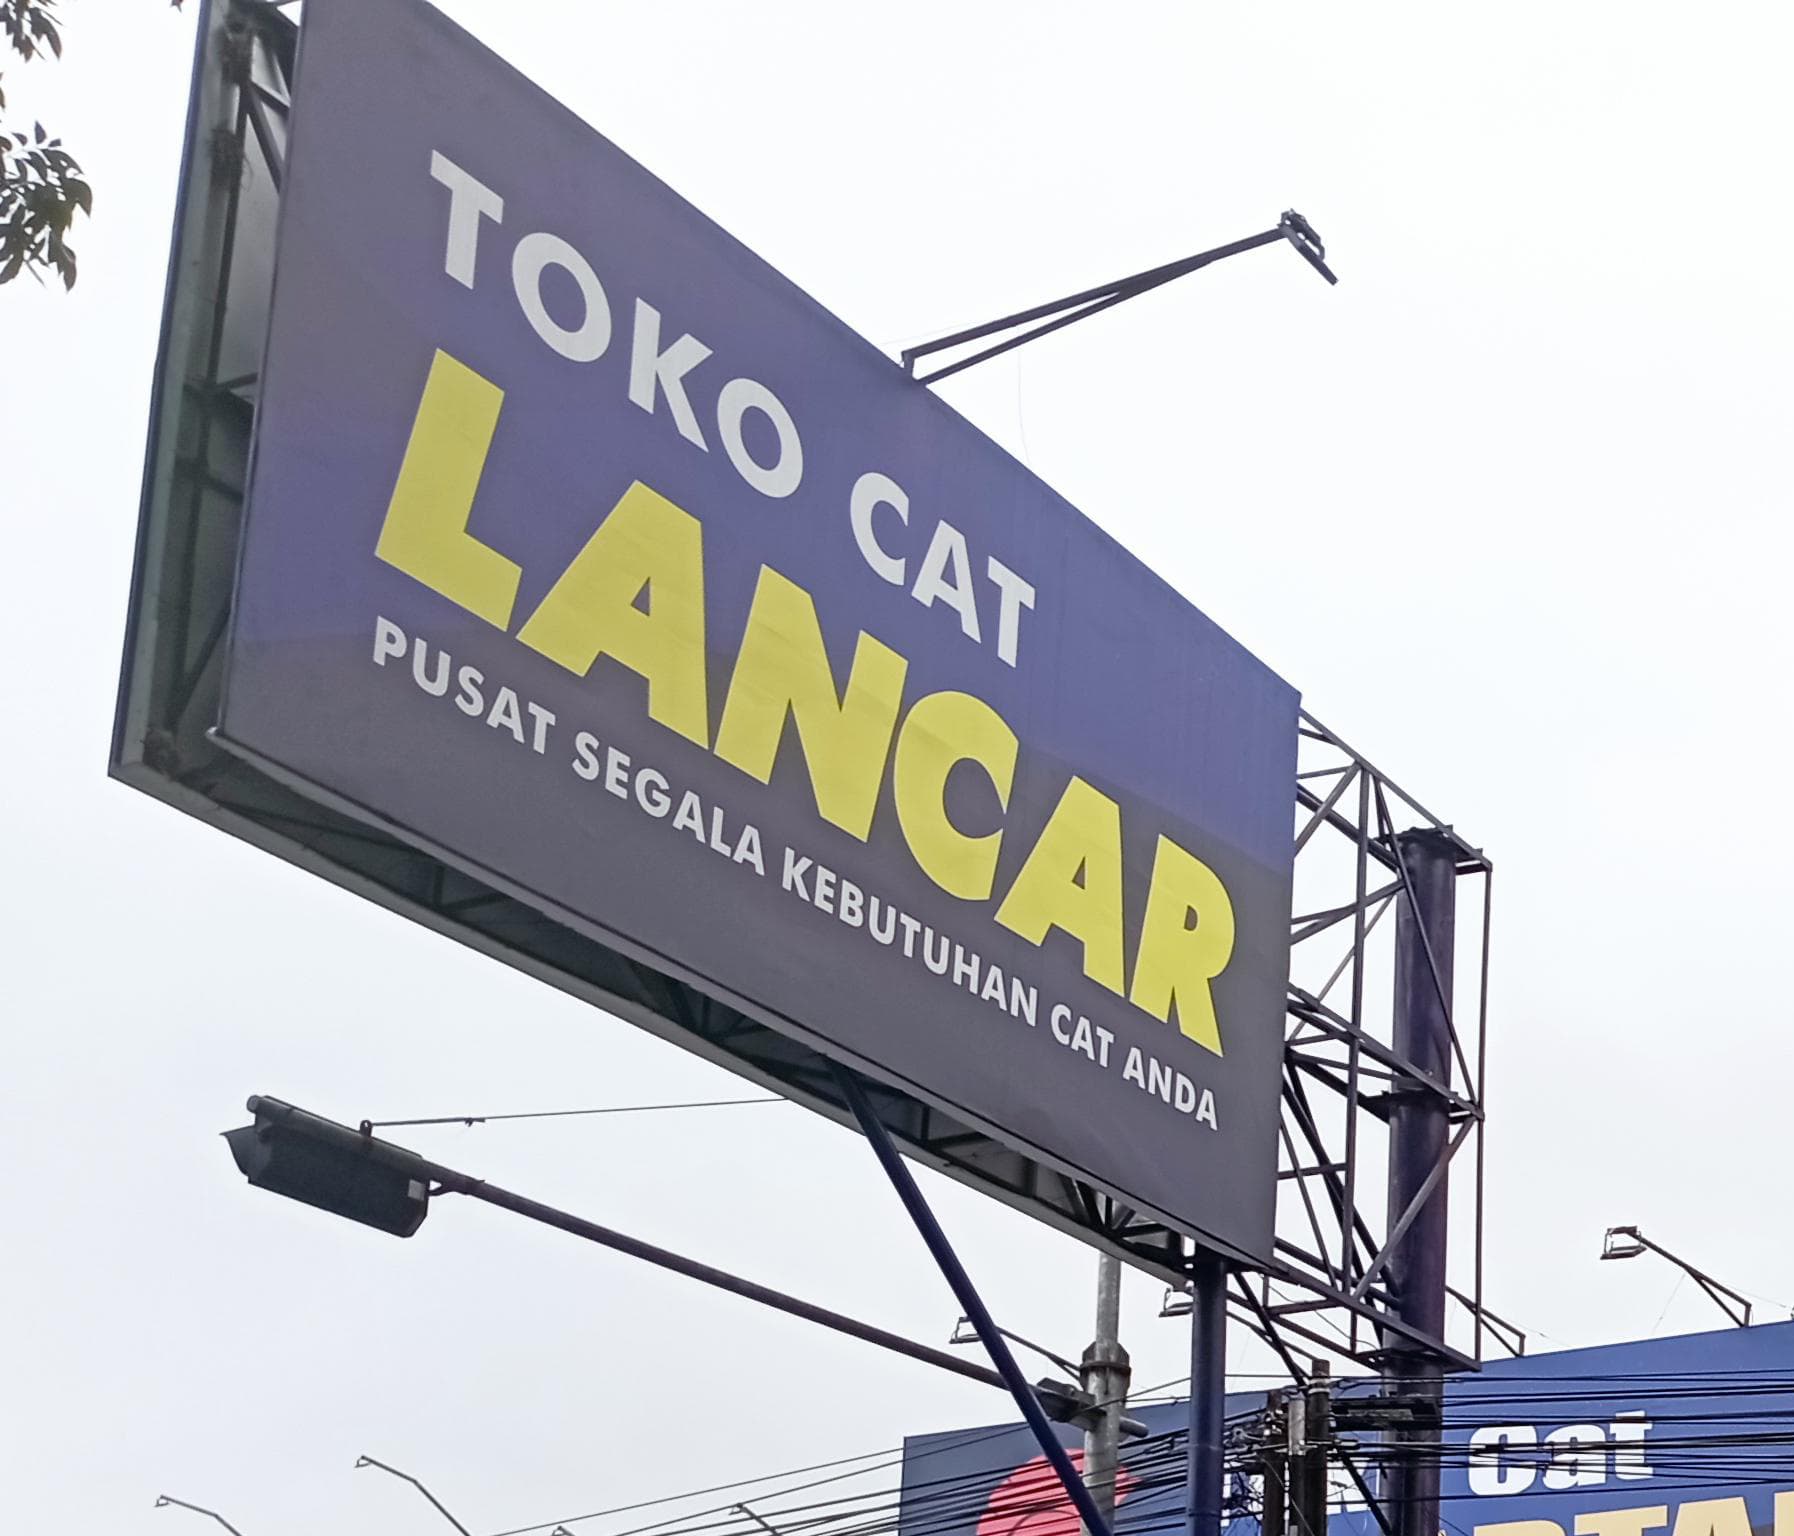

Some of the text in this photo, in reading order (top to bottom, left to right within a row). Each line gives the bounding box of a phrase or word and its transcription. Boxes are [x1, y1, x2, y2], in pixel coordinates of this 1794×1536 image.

[430, 149, 1035, 668] TOKO CAT
[373, 615, 1220, 1131] PUSAT SEGALA KEBUTUHAN CAT ANDA
[374, 347, 1236, 1058] LANCAR
[1469, 1411, 1654, 1496] Cat
